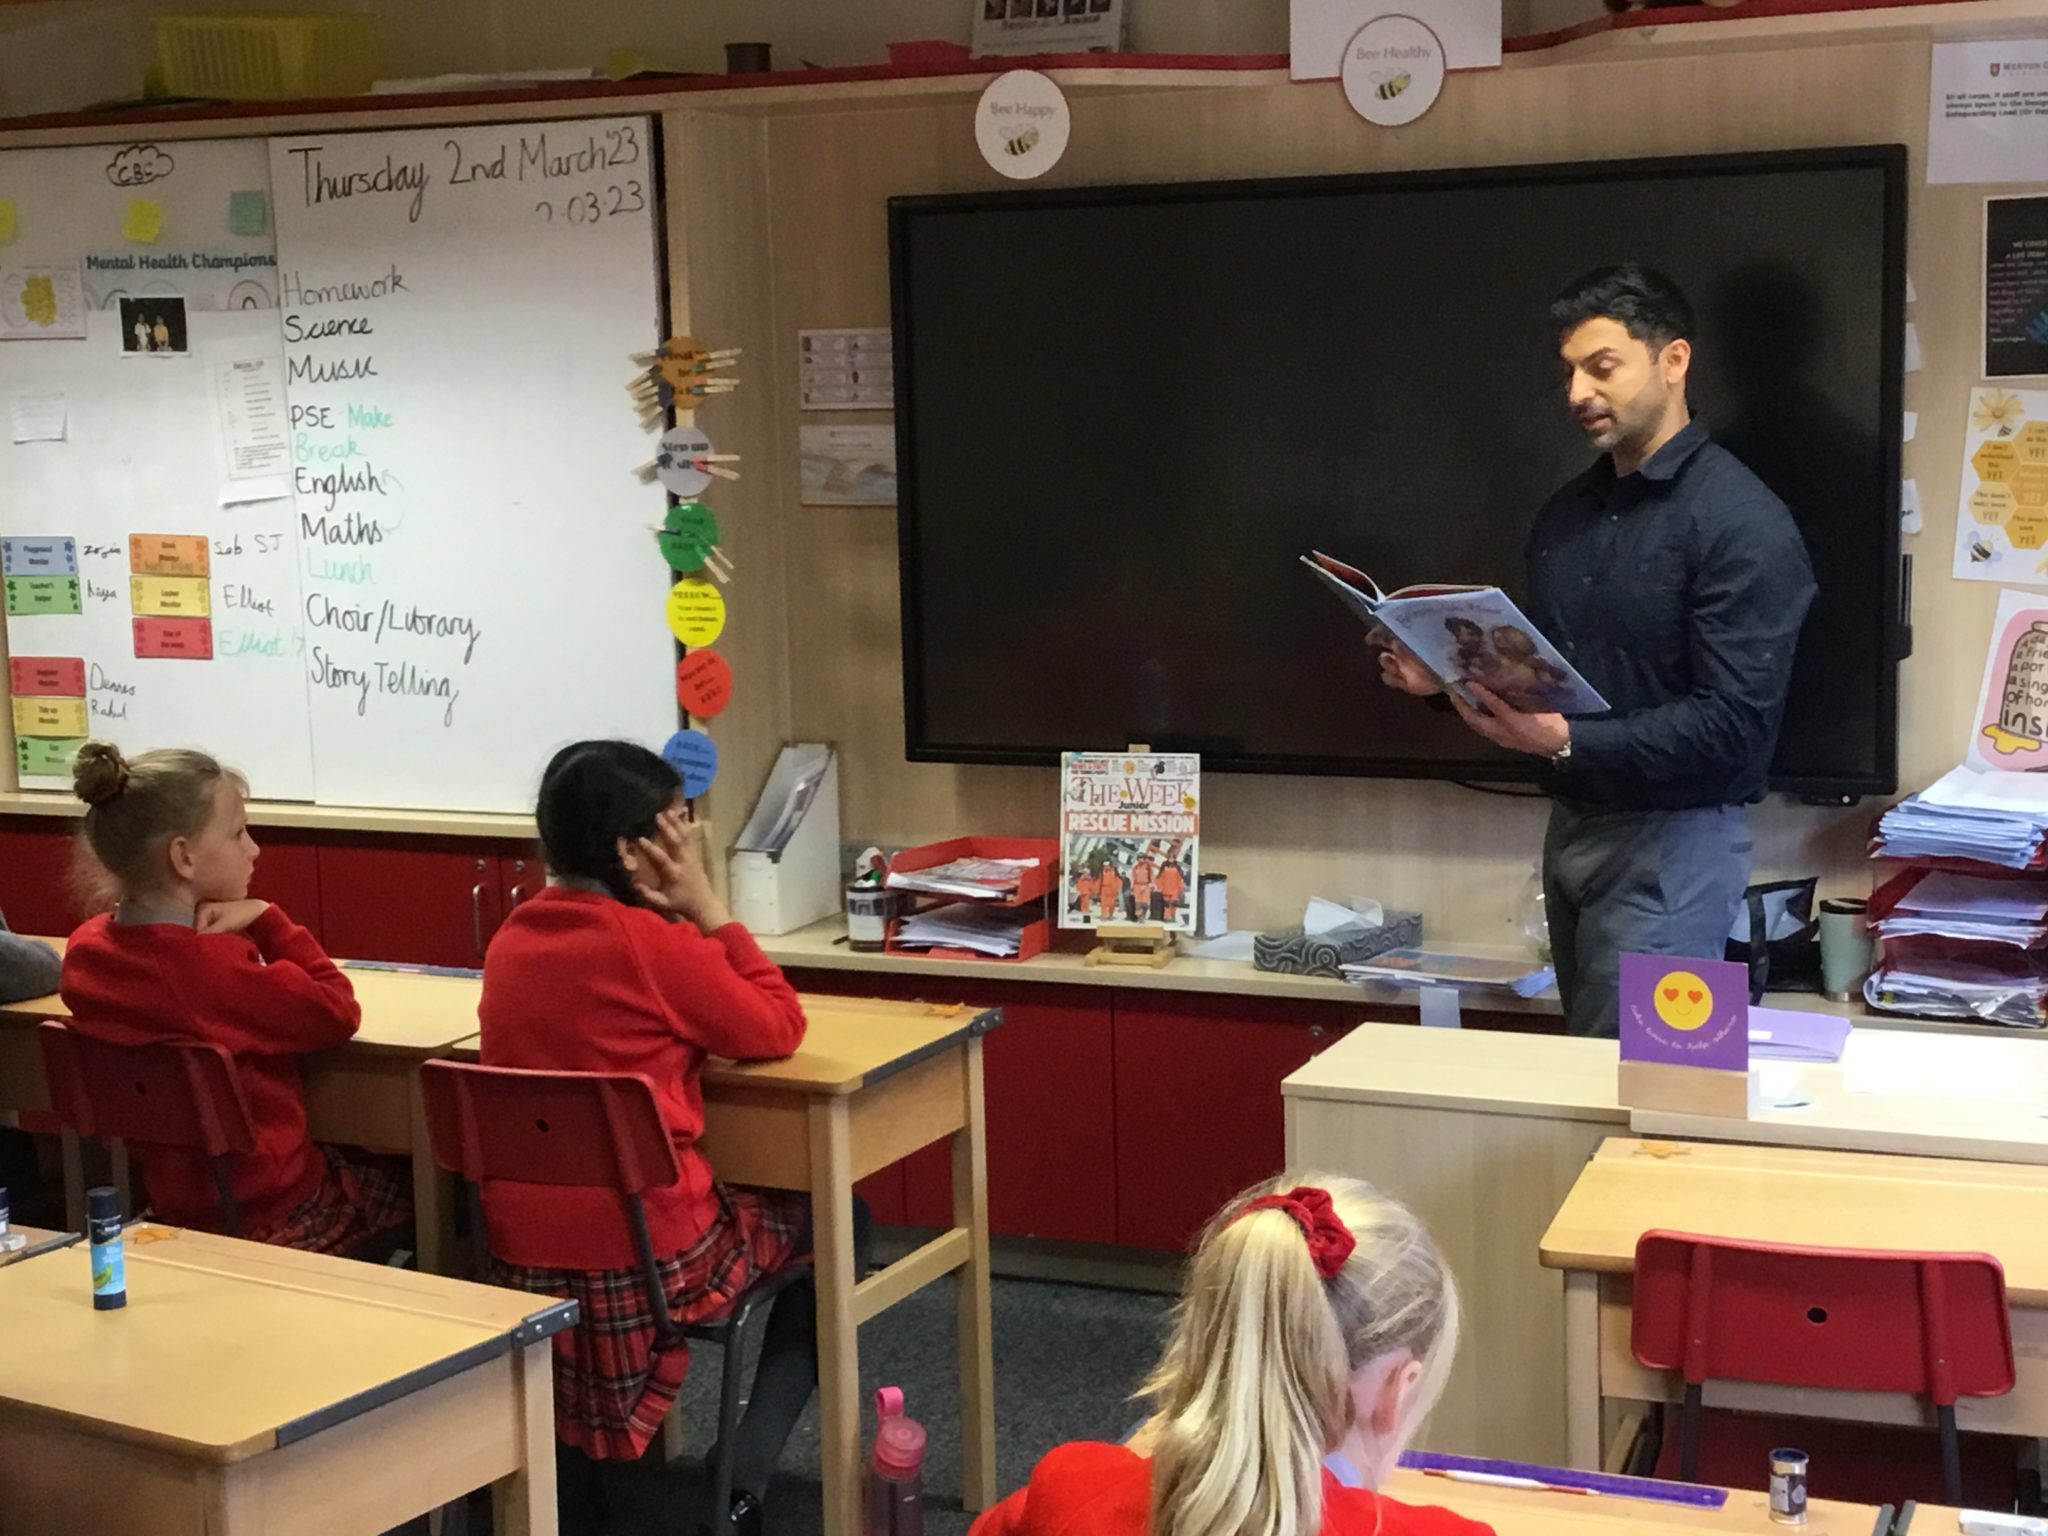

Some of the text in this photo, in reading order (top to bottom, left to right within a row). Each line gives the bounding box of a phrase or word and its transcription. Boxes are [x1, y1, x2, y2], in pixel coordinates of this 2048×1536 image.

[1355, 45, 1432, 62] Bee Healthy
[989, 102, 1056, 121] Bee Happy
[288, 146, 430, 223] Thursday
[444, 139, 507, 186] 2nd
[86, 252, 278, 272] Mental Health Champions
[282, 263, 413, 308] Homework
[284, 314, 374, 344] Science
[287, 354, 379, 386] Music
[289, 403, 336, 431] PSE
[294, 431, 369, 463] Break
[2028, 447, 2045, 458] YET
[295, 461, 388, 513] English
[1986, 470, 2003, 481] YET
[301, 511, 384, 546] Maths
[1982, 511, 1999, 521] YET
[214, 533, 244, 556] Seb
[2019, 535, 2036, 545] YET
[306, 546, 378, 585] Lunch
[305, 592, 483, 666] Choir/Library
[310, 644, 460, 729] Story Telling
[1070, 776, 1193, 807] THE WEEK
[1117, 800, 1150, 810] Junior
[1067, 812, 1195, 834] RESCUE MISSION
